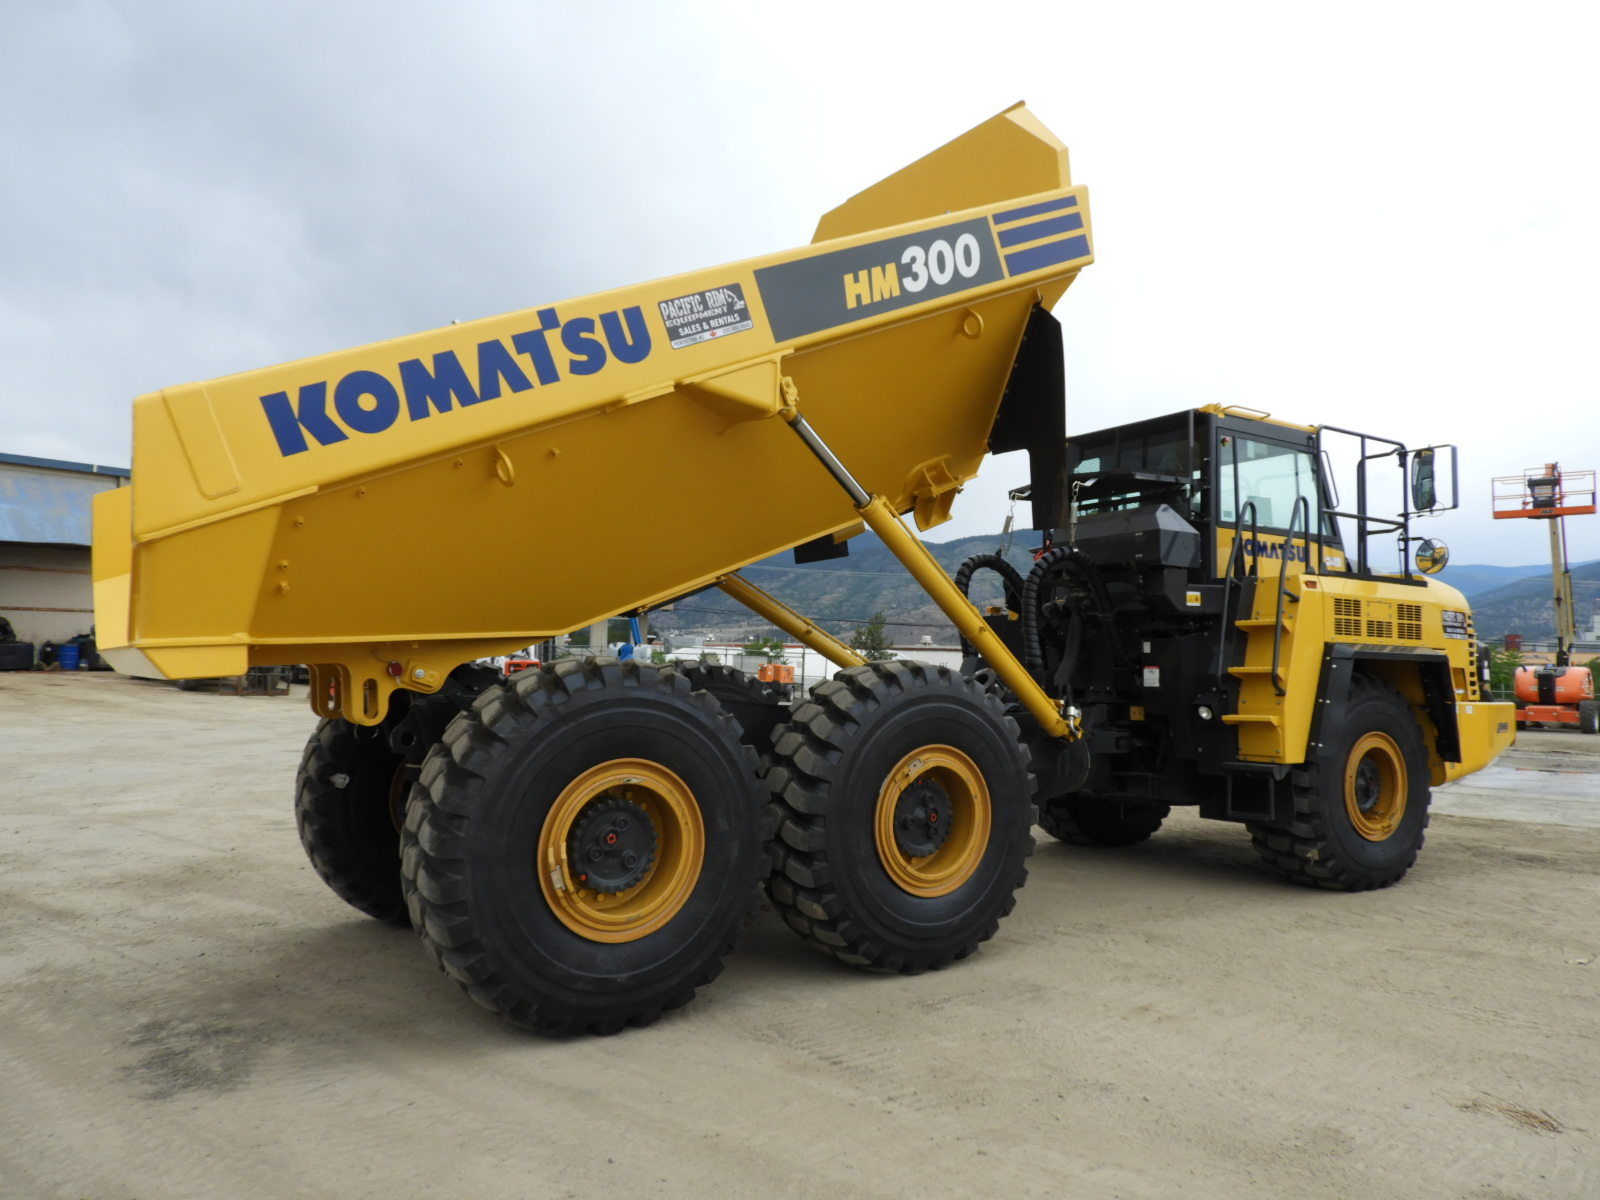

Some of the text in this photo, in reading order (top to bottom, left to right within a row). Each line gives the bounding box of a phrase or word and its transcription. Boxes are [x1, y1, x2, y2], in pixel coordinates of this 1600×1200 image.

[660, 288, 726, 320] PACIFIC RIM
[665, 306, 728, 328] EQUIPMENT
[678, 323, 701, 337] SALES
[702, 321, 710, 330] &
[709, 313, 741, 328] RENTALS
[259, 305, 652, 458] KOMATSU
